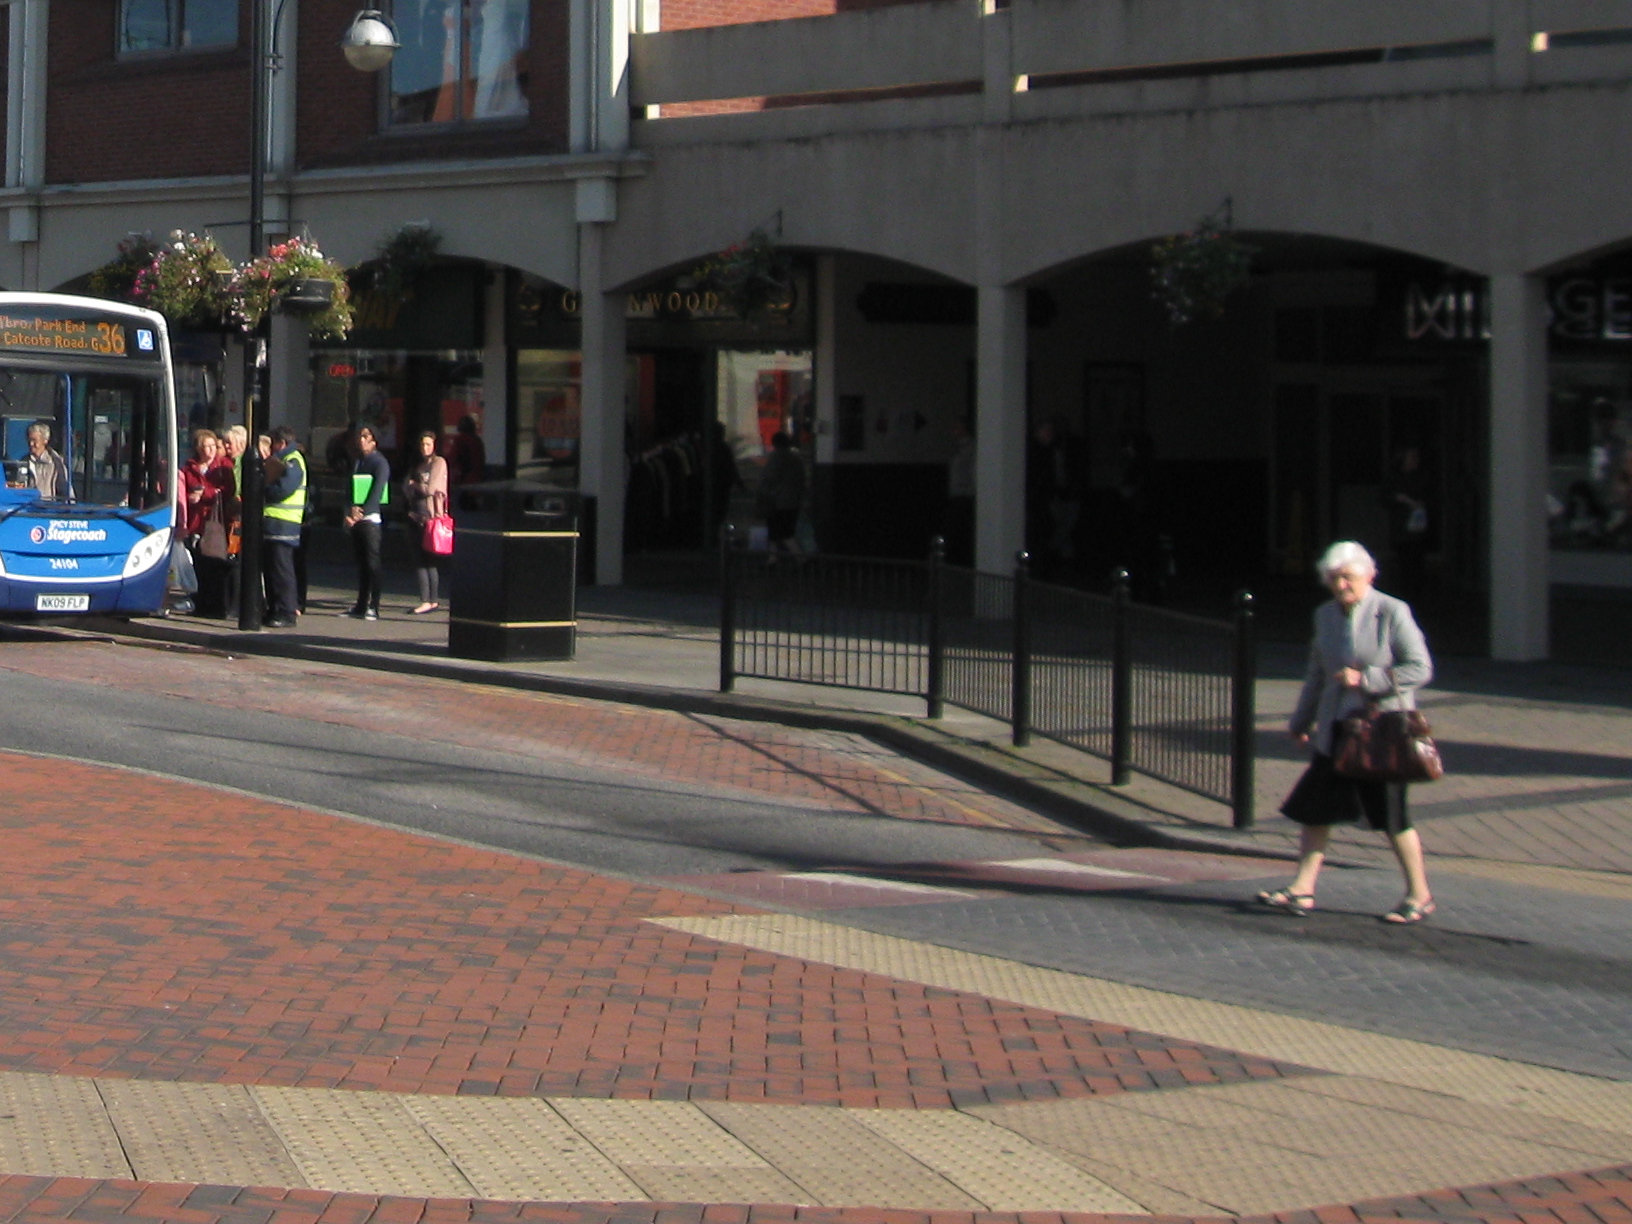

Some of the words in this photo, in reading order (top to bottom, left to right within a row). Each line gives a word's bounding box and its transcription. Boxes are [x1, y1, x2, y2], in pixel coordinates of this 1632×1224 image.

[560, 290, 720, 313] GNWOOD
[35, 317, 62, 332] Park
[65, 319, 86, 334] End
[97, 322, 126, 355] 36
[328, 364, 356, 377] OPEN
[46, 528, 107, 544] Stagecoach
[48, 558, 79, 570] 24104
[41, 597, 66, 606] NK09
[67, 597, 85, 607] FLP
